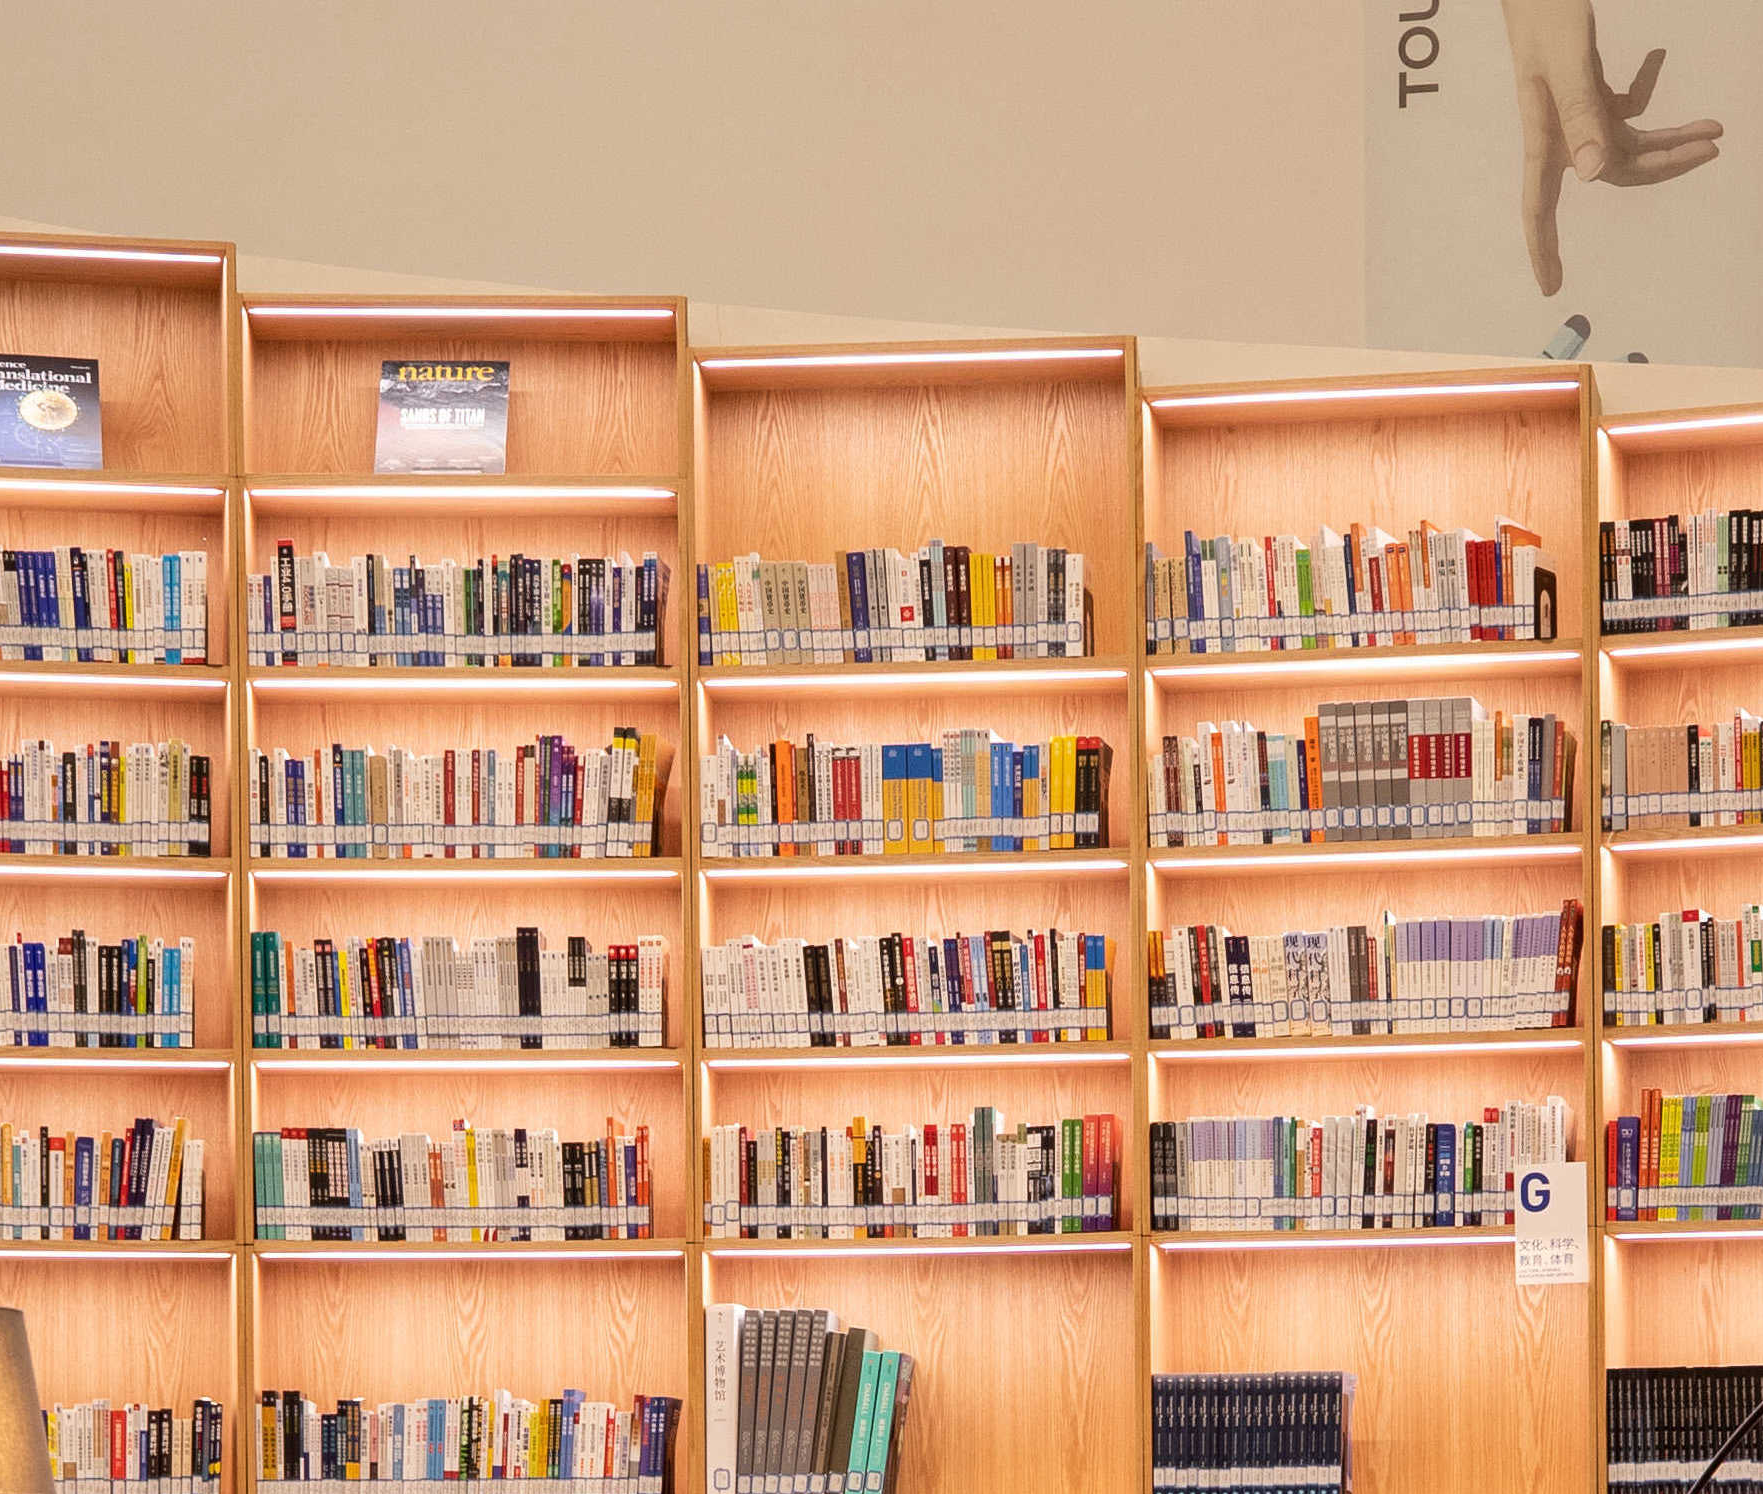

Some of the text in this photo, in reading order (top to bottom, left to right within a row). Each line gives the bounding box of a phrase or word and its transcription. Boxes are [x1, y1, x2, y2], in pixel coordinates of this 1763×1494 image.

[398, 365, 495, 382] nature
[400, 408, 437, 425] SANDS
[437, 408, 453, 424] OF
[1520, 1172, 1551, 1213] G
[714, 1339, 727, 1401] 艺术博物馆
